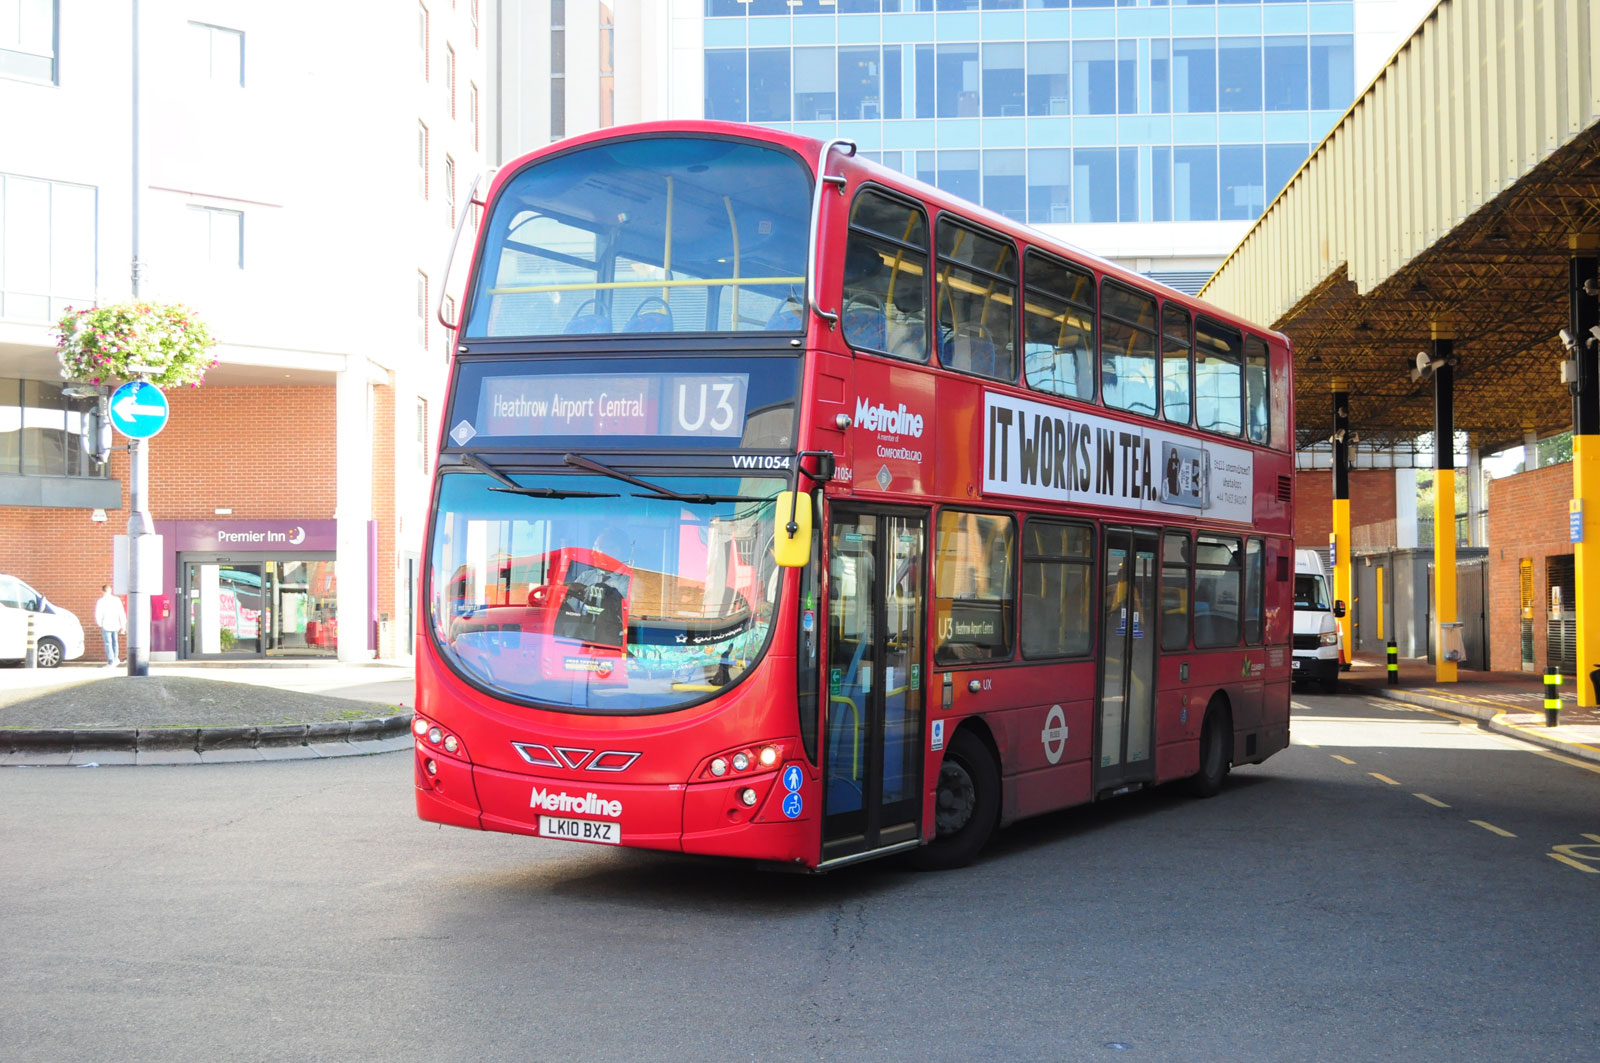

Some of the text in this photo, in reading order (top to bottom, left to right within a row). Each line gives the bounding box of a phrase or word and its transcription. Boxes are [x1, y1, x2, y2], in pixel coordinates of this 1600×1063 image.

[493, 392, 645, 424] Heathrow Airport Central
[678, 383, 735, 431] U3
[853, 395, 924, 438] Metroline
[732, 455, 790, 469] VW1054
[988, 405, 1013, 482] IT
[1018, 410, 1091, 492] WORKS
[1096, 427, 1115, 496] IN
[1119, 432, 1157, 501] TEA.
[218, 530, 286, 542] Premier Inn
[938, 616, 953, 639] U3
[982, 679, 992, 691] UX
[529, 786, 622, 817] Metroline
[583, 822, 611, 840] BXZ
